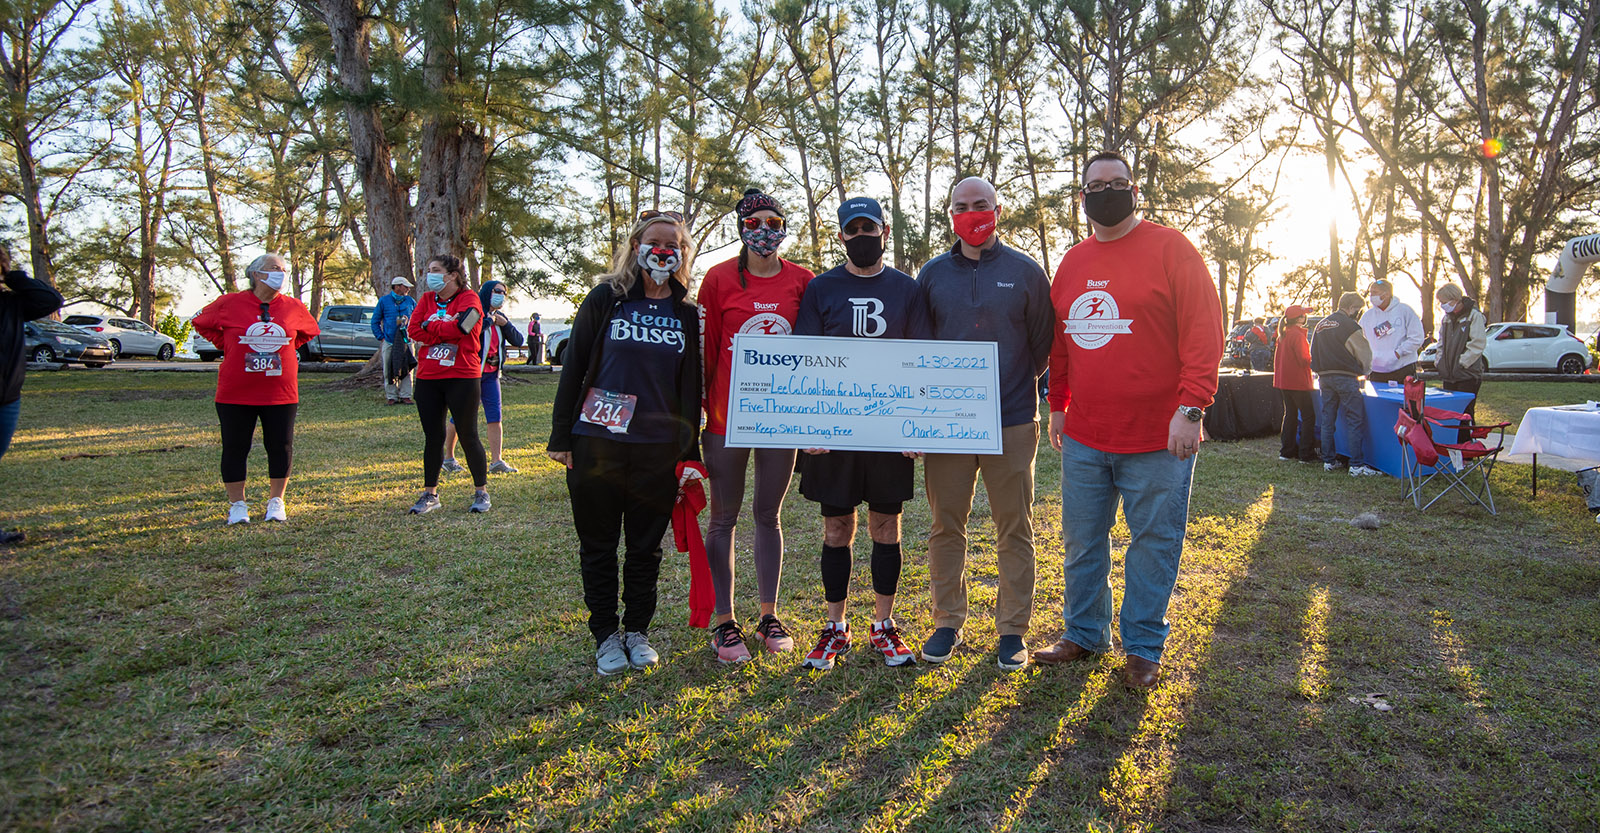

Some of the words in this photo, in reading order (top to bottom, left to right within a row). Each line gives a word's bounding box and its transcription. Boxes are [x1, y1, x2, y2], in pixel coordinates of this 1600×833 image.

[1572, 237, 1600, 258] FINI
[1086, 279, 1110, 288] Busey
[753, 301, 780, 311] Busey
[610, 318, 686, 353] Busey
[431, 347, 450, 359] 269
[917, 355, 989, 369] 1-30-2021
[253, 358, 274, 370] 384
[770, 373, 787, 394] Lee
[801, 376, 836, 396] Coalition
[837, 381, 847, 396] for
[853, 382, 872, 401] Drug
[871, 384, 887, 398] Free
[888, 384, 914, 399] SWFL
[919, 387, 926, 397] $
[591, 400, 623, 425] 234
[739, 398, 764, 413] Five
[763, 398, 820, 415] Thousand
[820, 401, 862, 416] Dollars
[755, 422, 778, 437] Keep
[779, 423, 806, 435] SWFL
[807, 425, 832, 440] Drug
[833, 426, 853, 436] Free
[901, 419, 945, 438] Charles
